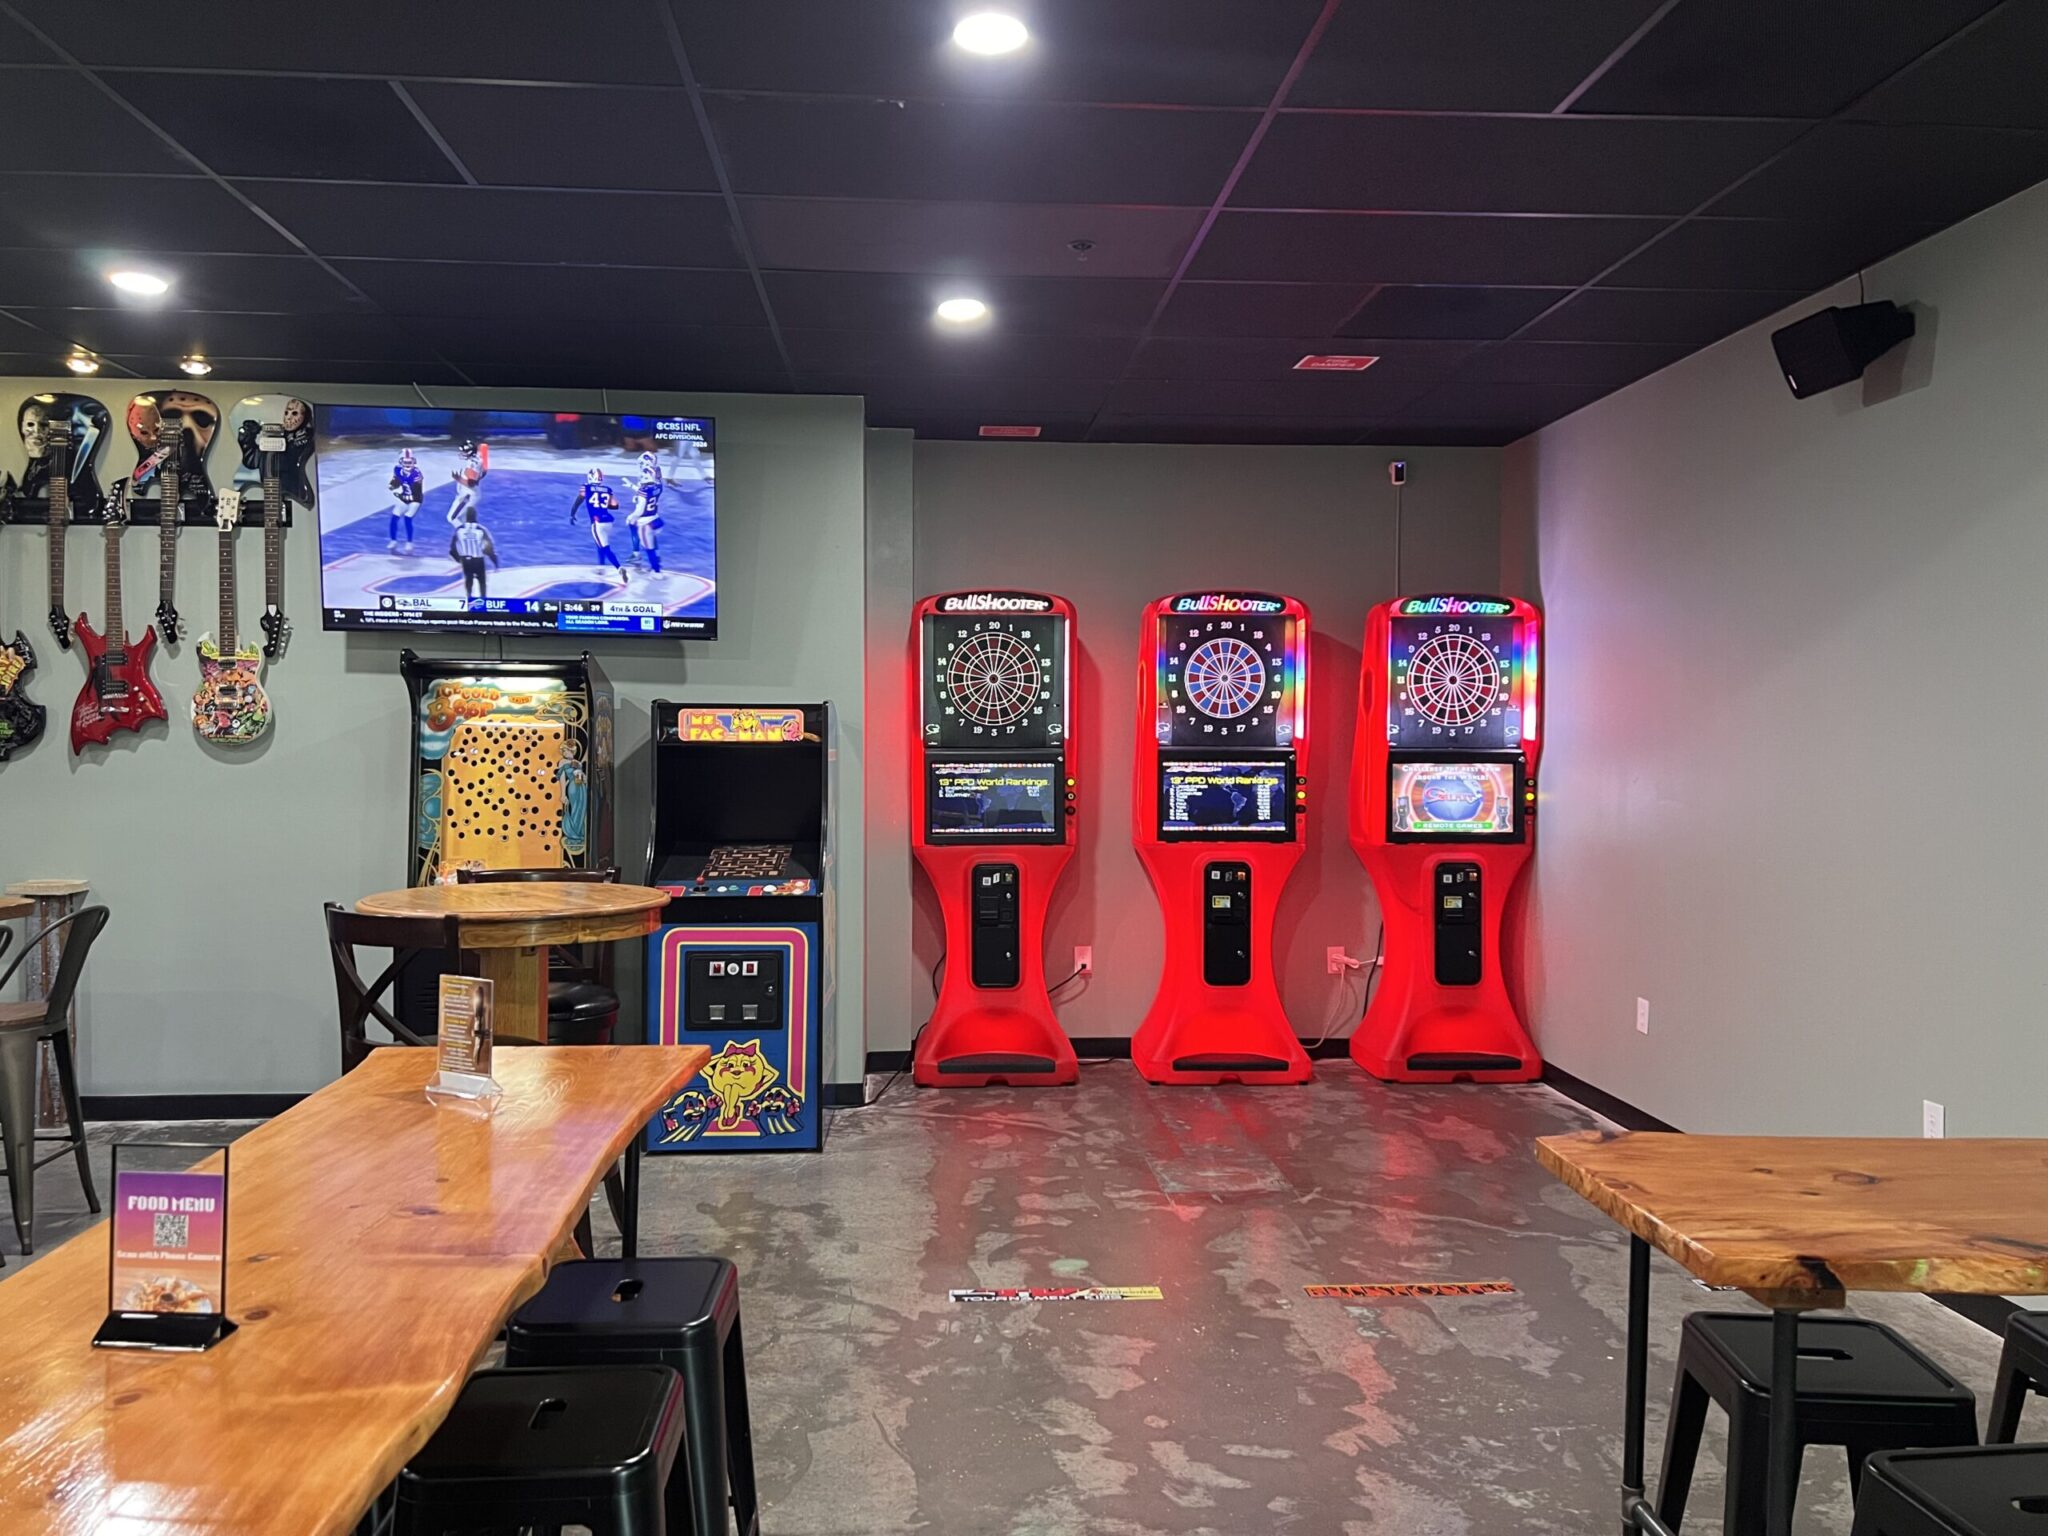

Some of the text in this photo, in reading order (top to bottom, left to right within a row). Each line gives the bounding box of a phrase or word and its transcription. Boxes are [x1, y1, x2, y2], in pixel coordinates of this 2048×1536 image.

[664, 422, 702, 431] CBS NFL
[589, 492, 610, 508] 43
[412, 599, 432, 607] BAL
[458, 600, 466, 609] 7
[486, 600, 506, 609] BUF
[525, 601, 539, 612] 14
[564, 603, 583, 612] 3:46
[590, 604, 600, 612] 39
[633, 605, 656, 613] GOAL
[436, 683, 501, 701] ICE COLD
[1006, 778, 1048, 787] Rankings
[1236, 777, 1278, 786] Rankings
[128, 1196, 215, 1212] FOOD MENU
[138, 1251, 159, 1259] with
[160, 1251, 186, 1260] Phone
[187, 1252, 221, 1261] Camera
